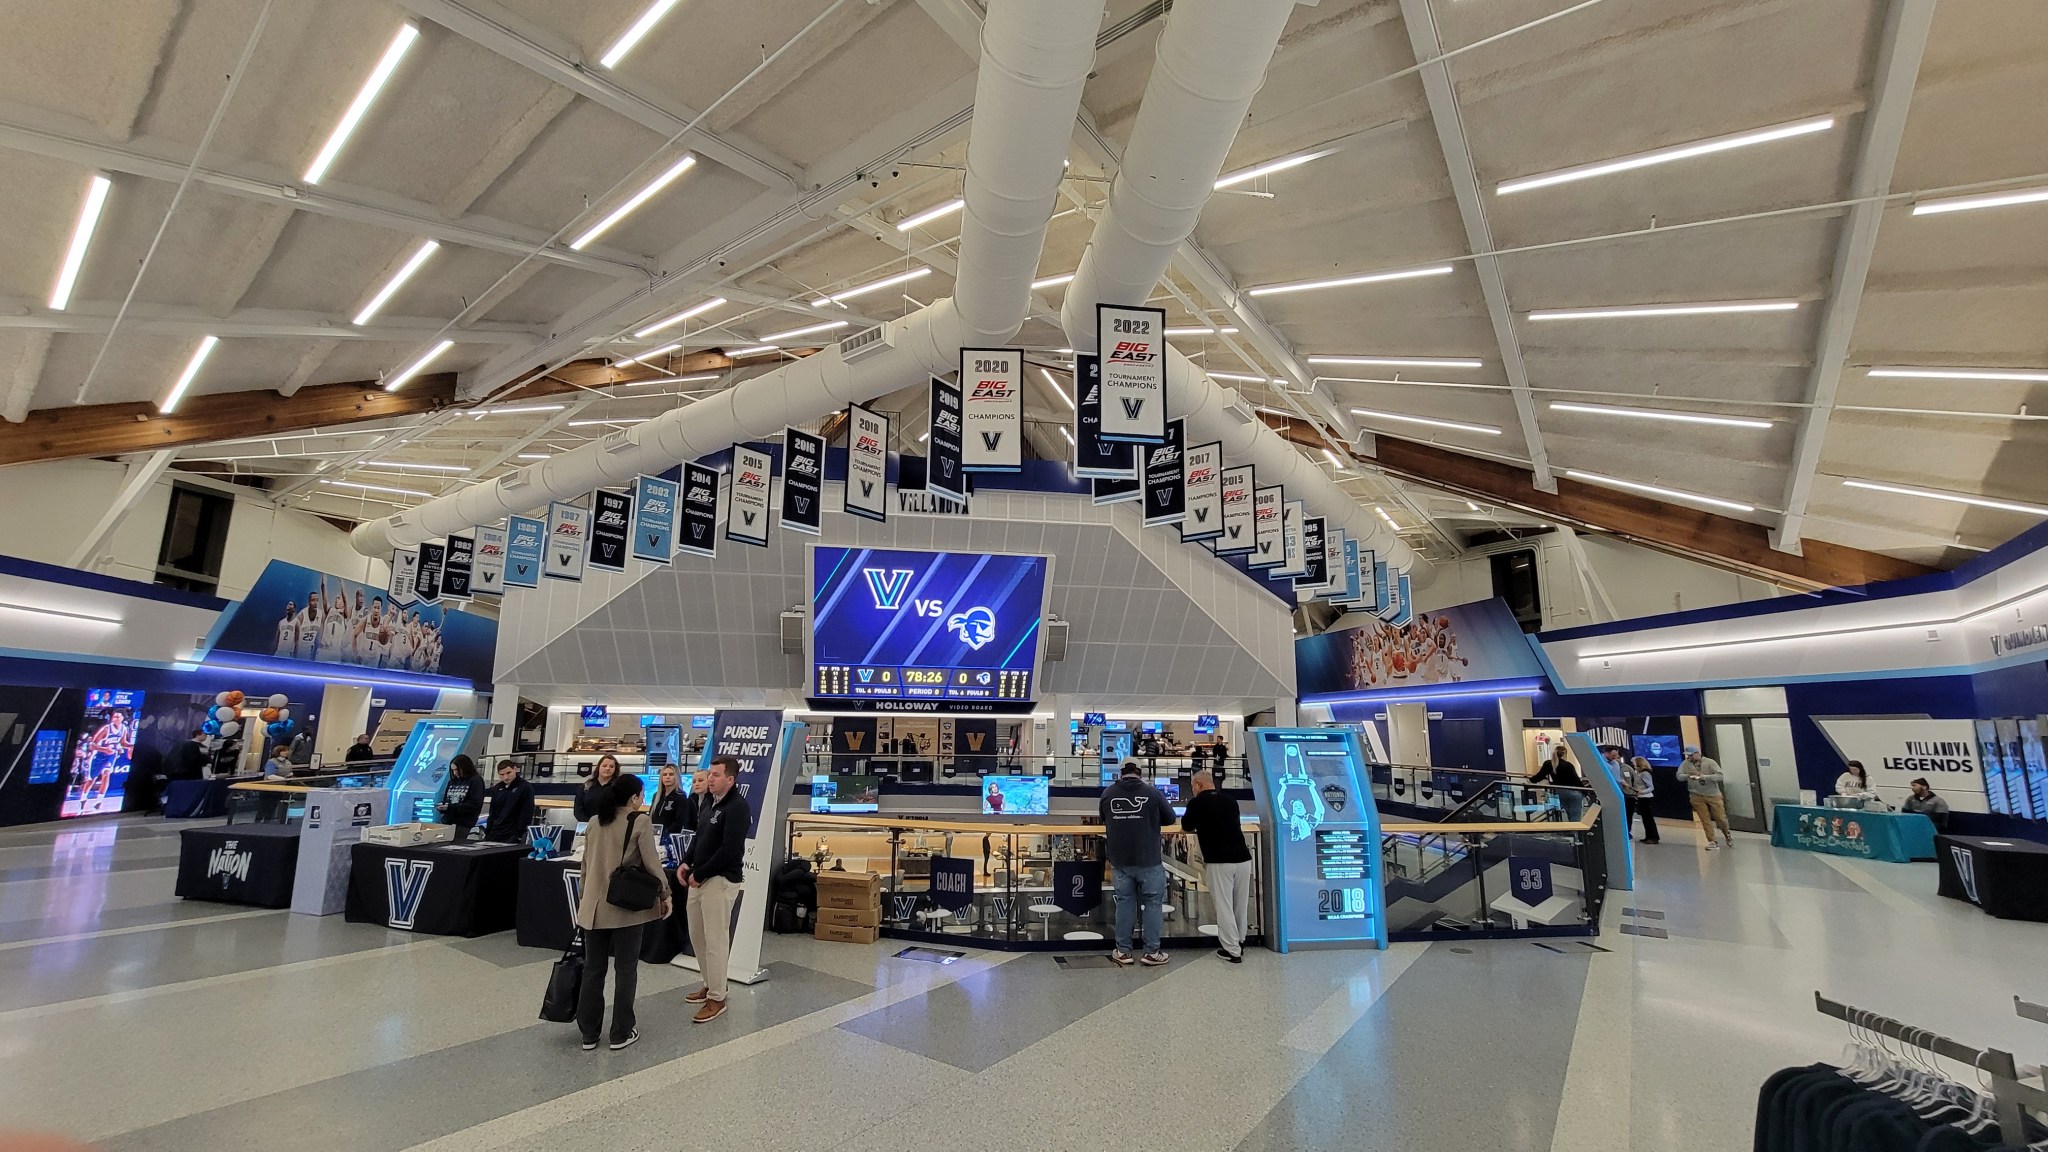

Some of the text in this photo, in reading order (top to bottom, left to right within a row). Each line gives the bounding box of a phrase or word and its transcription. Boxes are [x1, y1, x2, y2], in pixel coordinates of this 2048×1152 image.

[1113, 318, 1150, 335] 2022
[1115, 341, 1150, 352] BIG
[1109, 351, 1158, 362] EAST
[974, 359, 1009, 374] 2020
[1108, 373, 1156, 381] TOURNAMENT
[976, 380, 1008, 389] BIG
[1107, 380, 1158, 390] CHAMPIONS
[939, 389, 959, 410] 2019
[971, 389, 1017, 398] EAST
[1119, 396, 1145, 420] V
[939, 409, 959, 424] BIG
[859, 417, 879, 435] 2018
[935, 416, 961, 433] EAST
[794, 437, 816, 454] 2016
[858, 435, 879, 447] BIG
[933, 437, 960, 453] CHAMPION
[979, 430, 1004, 453] V
[855, 443, 884, 456] EAST
[1152, 445, 1177, 457] BIG
[742, 455, 763, 470] 2015
[793, 454, 816, 466] BIG
[854, 458, 881, 471] TOURNAMENT
[1149, 451, 1182, 465] EAST
[1189, 452, 1211, 467] 2017
[790, 461, 820, 474] EAST
[852, 463, 882, 478] CHAMPIONS
[940, 455, 955, 479] V
[1190, 467, 1211, 478] BIG
[691, 471, 711, 486] 2014
[741, 471, 762, 481] BIG
[1147, 474, 1181, 485] CHAMPIONS
[1148, 469, 1180, 479] TOURNAMENT
[1187, 473, 1217, 485] EAST
[1222, 474, 1244, 487] 2015
[738, 476, 766, 489] EAST
[788, 479, 819, 492] CHAMPIONS
[860, 478, 874, 499] V
[687, 492, 715, 503] EAST
[690, 486, 711, 496] BIG
[1156, 487, 1173, 506] V
[1224, 488, 1245, 497] BIG
[603, 497, 624, 510] 1997
[643, 505, 671, 514] EAST
[646, 498, 667, 508] BIG
[734, 497, 765, 509] CHAMPIONS
[794, 495, 810, 514] V
[601, 510, 623, 519] BIG
[685, 508, 714, 519] CHAMPIONS
[742, 510, 756, 526] V
[1193, 507, 1209, 523] V
[559, 522, 578, 530] BIG
[599, 516, 627, 526] EAST
[640, 521, 670, 532] CHAMPIONS
[556, 528, 583, 536] EAST
[595, 530, 625, 541] CHAMPIONS
[691, 522, 706, 539] V
[1228, 525, 1242, 539] V
[454, 540, 472, 551] 1982
[513, 539, 539, 547] EAST
[647, 532, 661, 548] V
[429, 548, 442, 560] V
[602, 542, 617, 558] V
[1259, 541, 1272, 554] V
[404, 555, 416, 566] V
[559, 553, 572, 567] V
[446, 567, 471, 575] CHAMPION
[517, 564, 528, 576] V
[452, 577, 465, 590] V
[482, 571, 496, 583] V
[863, 568, 914, 610] V
[914, 599, 943, 617] VS
[283, 631, 288, 641] 2
[302, 632, 314, 642] 25
[402, 633, 407, 645] 3
[857, 668, 891, 682] V 0
[906, 671, 943, 683] 78:26
[959, 673, 968, 684] 0
[875, 701, 939, 711] HOLLOWAY
[723, 725, 770, 740] PURSUE
[844, 731, 866, 751] V
[965, 732, 986, 752] V
[718, 742, 772, 757] THE NEXT
[1905, 741, 1971, 757] VILLANOVA
[736, 759, 755, 773] OU.
[1883, 757, 1974, 773] LEGENDS
[224, 840, 240, 850] THE
[747, 846, 755, 855] of
[207, 847, 253, 882] NATION
[1519, 868, 1543, 890] 33
[1949, 845, 1982, 905] V
[936, 871, 967, 893] COACH
[1071, 874, 1085, 898] 2
[385, 857, 434, 930] V
[1318, 887, 1366, 913] 2018
[894, 895, 918, 920] V
[993, 896, 1016, 919] V
